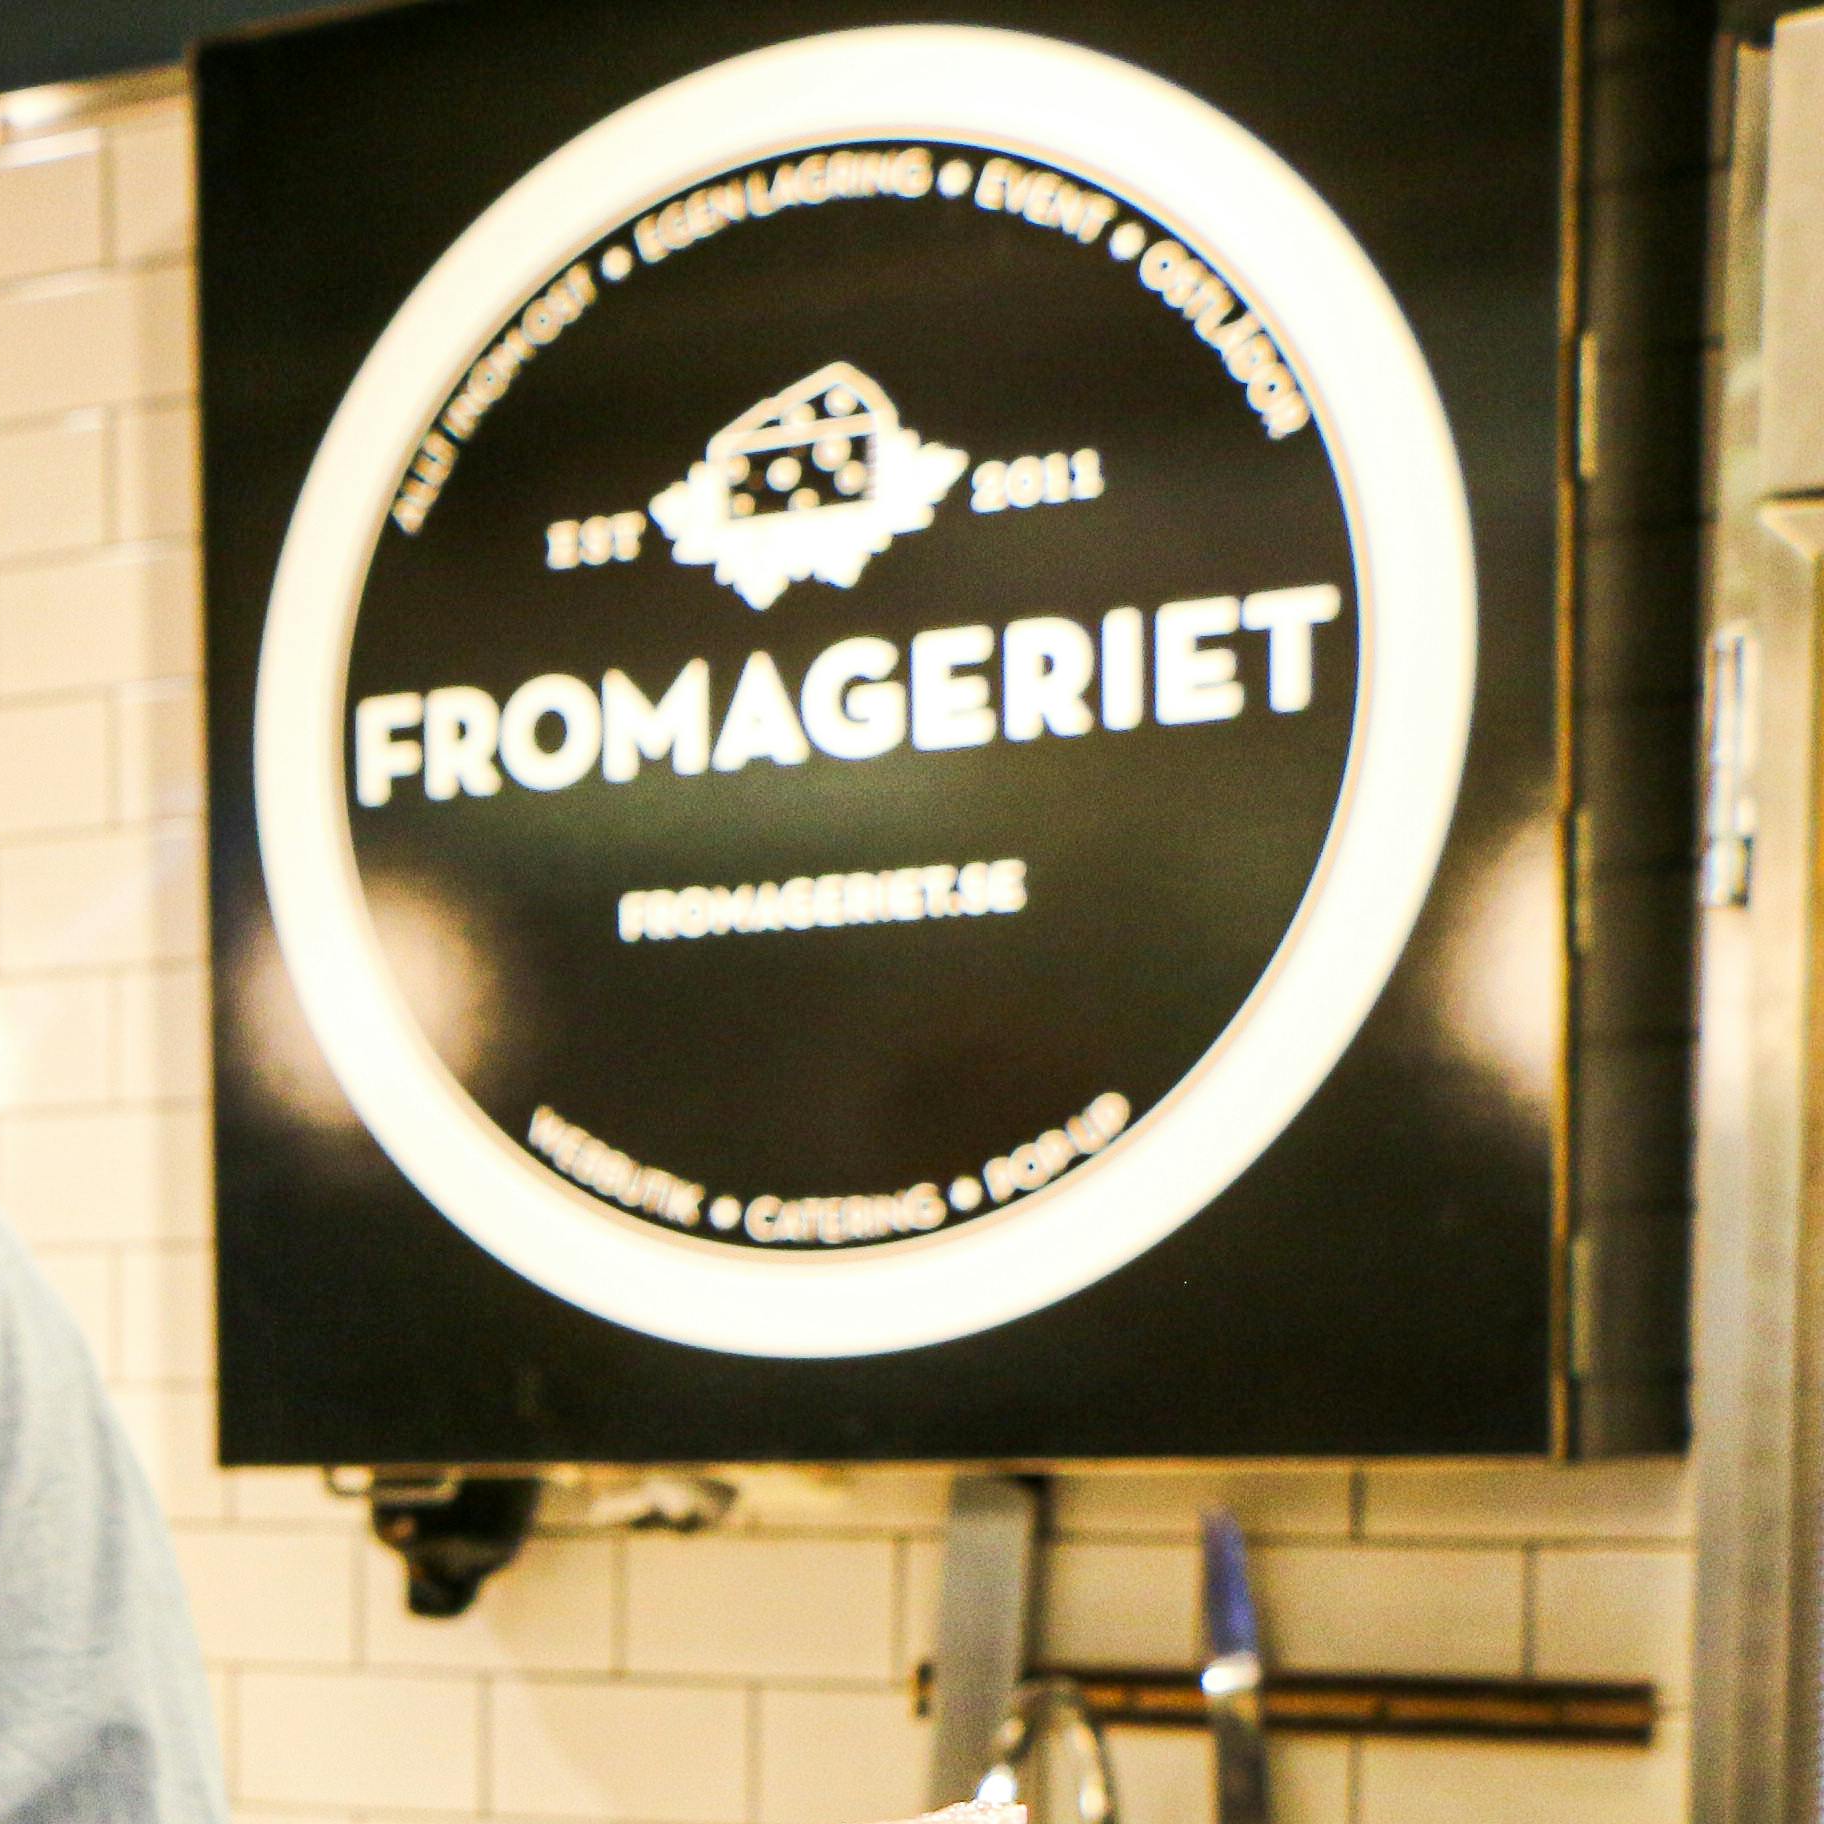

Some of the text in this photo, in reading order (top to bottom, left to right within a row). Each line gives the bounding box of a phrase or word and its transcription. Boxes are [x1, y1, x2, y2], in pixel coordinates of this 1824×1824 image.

[974, 157, 1118, 245] EVENT
[546, 447, 1106, 570] EST 2011
[354, 582, 1343, 809] FROMAGERIET
[616, 857, 1029, 944] FROMAGERIET.SE
